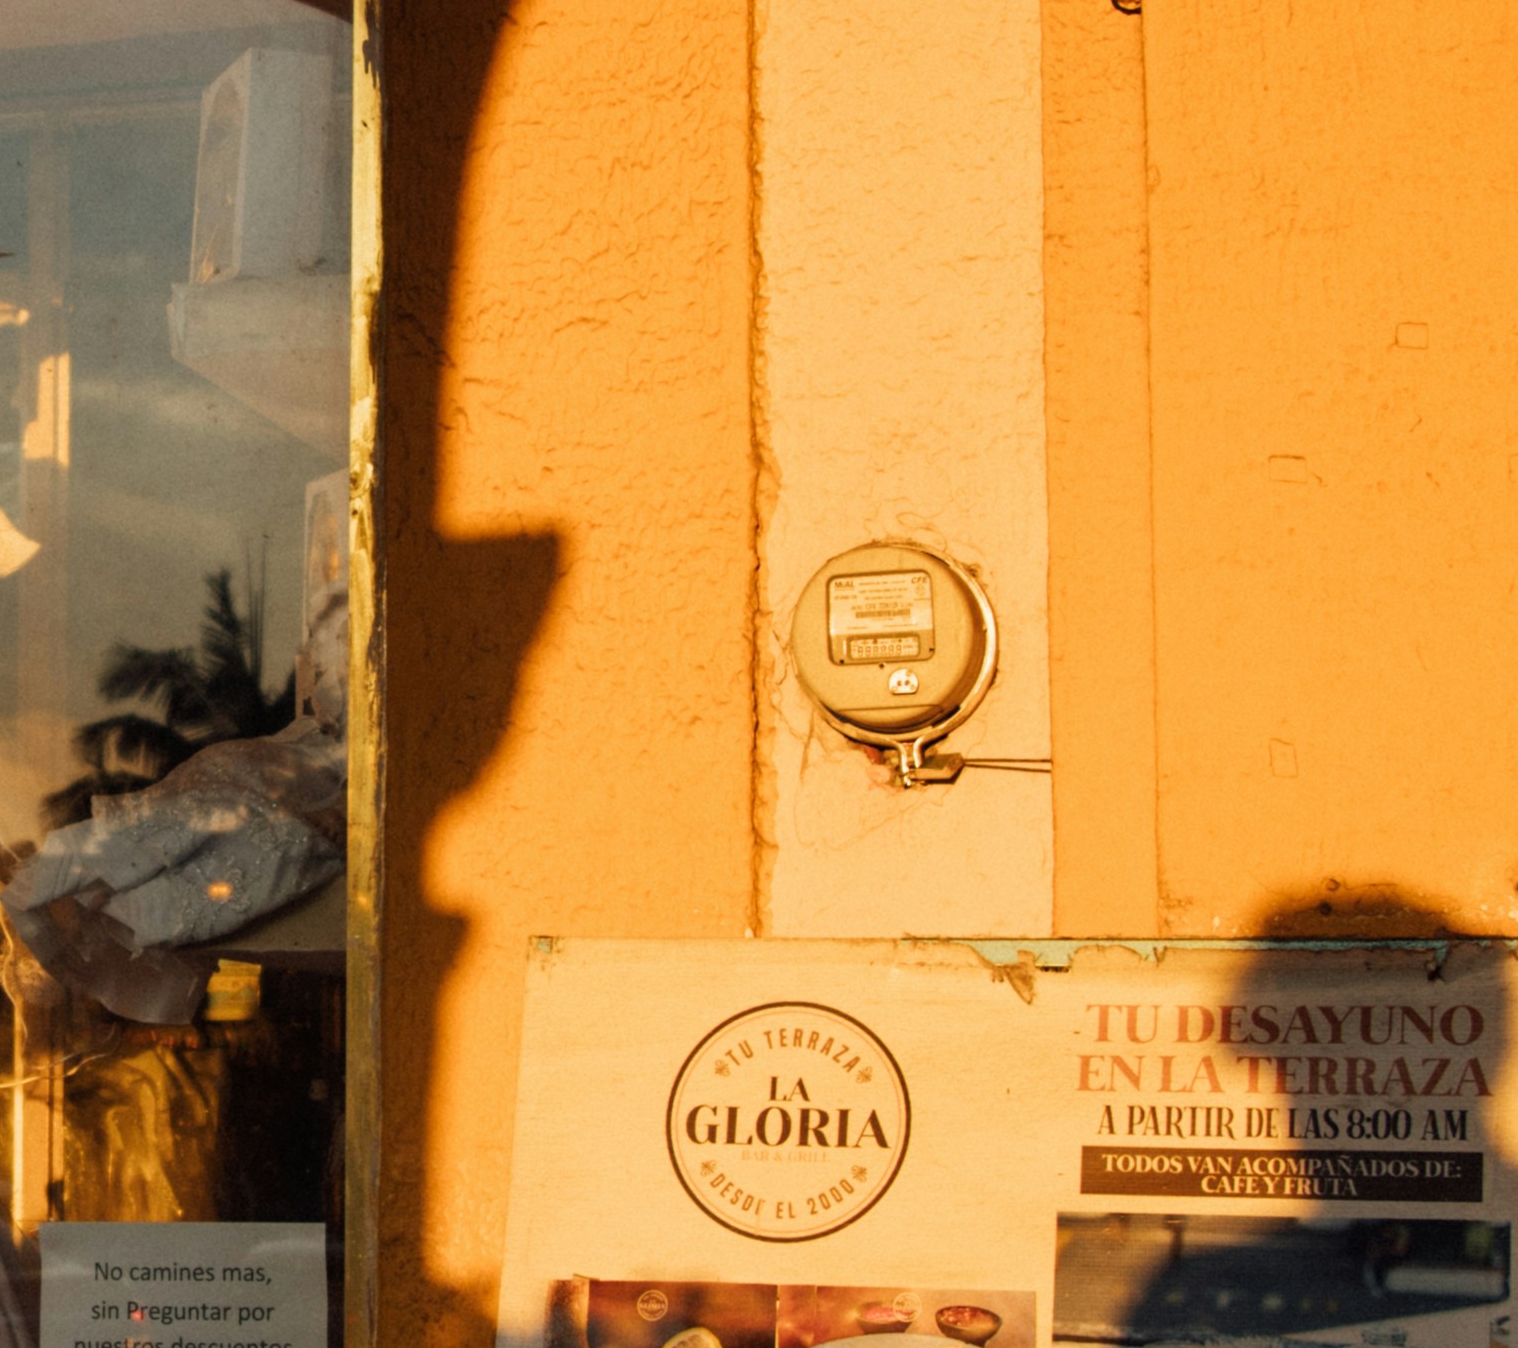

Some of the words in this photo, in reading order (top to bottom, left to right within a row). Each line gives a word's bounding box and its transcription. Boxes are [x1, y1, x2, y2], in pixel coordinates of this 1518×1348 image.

[1086, 1004, 1162, 1043] TU
[1174, 1004, 1485, 1047] DESAYUNO
[725, 1039, 755, 1066] TU
[763, 1027, 862, 1074] TERRAZA
[768, 1075, 811, 1103] LA
[1076, 1054, 1147, 1092] EN
[1157, 1055, 1225, 1094] LA
[1236, 1056, 1494, 1097] TERRAZA
[685, 1104, 892, 1149] GLORIA
[1097, 1104, 1116, 1136] A
[1127, 1104, 1237, 1140] PARTIR
[1245, 1107, 1280, 1139] DE
[1287, 1108, 1340, 1140] LAS
[1346, 1109, 1414, 1141] 8:00
[1420, 1110, 1469, 1141] AM
[1102, 1153, 1184, 1175] TODOS
[1185, 1155, 1236, 1176] VAN
[1236, 1153, 1419, 1179] ACOMPAÑADOS
[1424, 1159, 1462, 1180] DE:
[775, 1201, 797, 1219] EL
[806, 1177, 855, 1216] 2000
[1200, 1174, 1258, 1195] CAFE
[1262, 1176, 1282, 1195] Y
[1283, 1176, 1359, 1198] FRUTA
[94, 1262, 123, 1282] No
[129, 1262, 216, 1282] camines
[221, 1265, 273, 1286] mas,
[91, 1300, 120, 1320] sin
[126, 1301, 232, 1326] Preguntar
[237, 1305, 275, 1326] por
